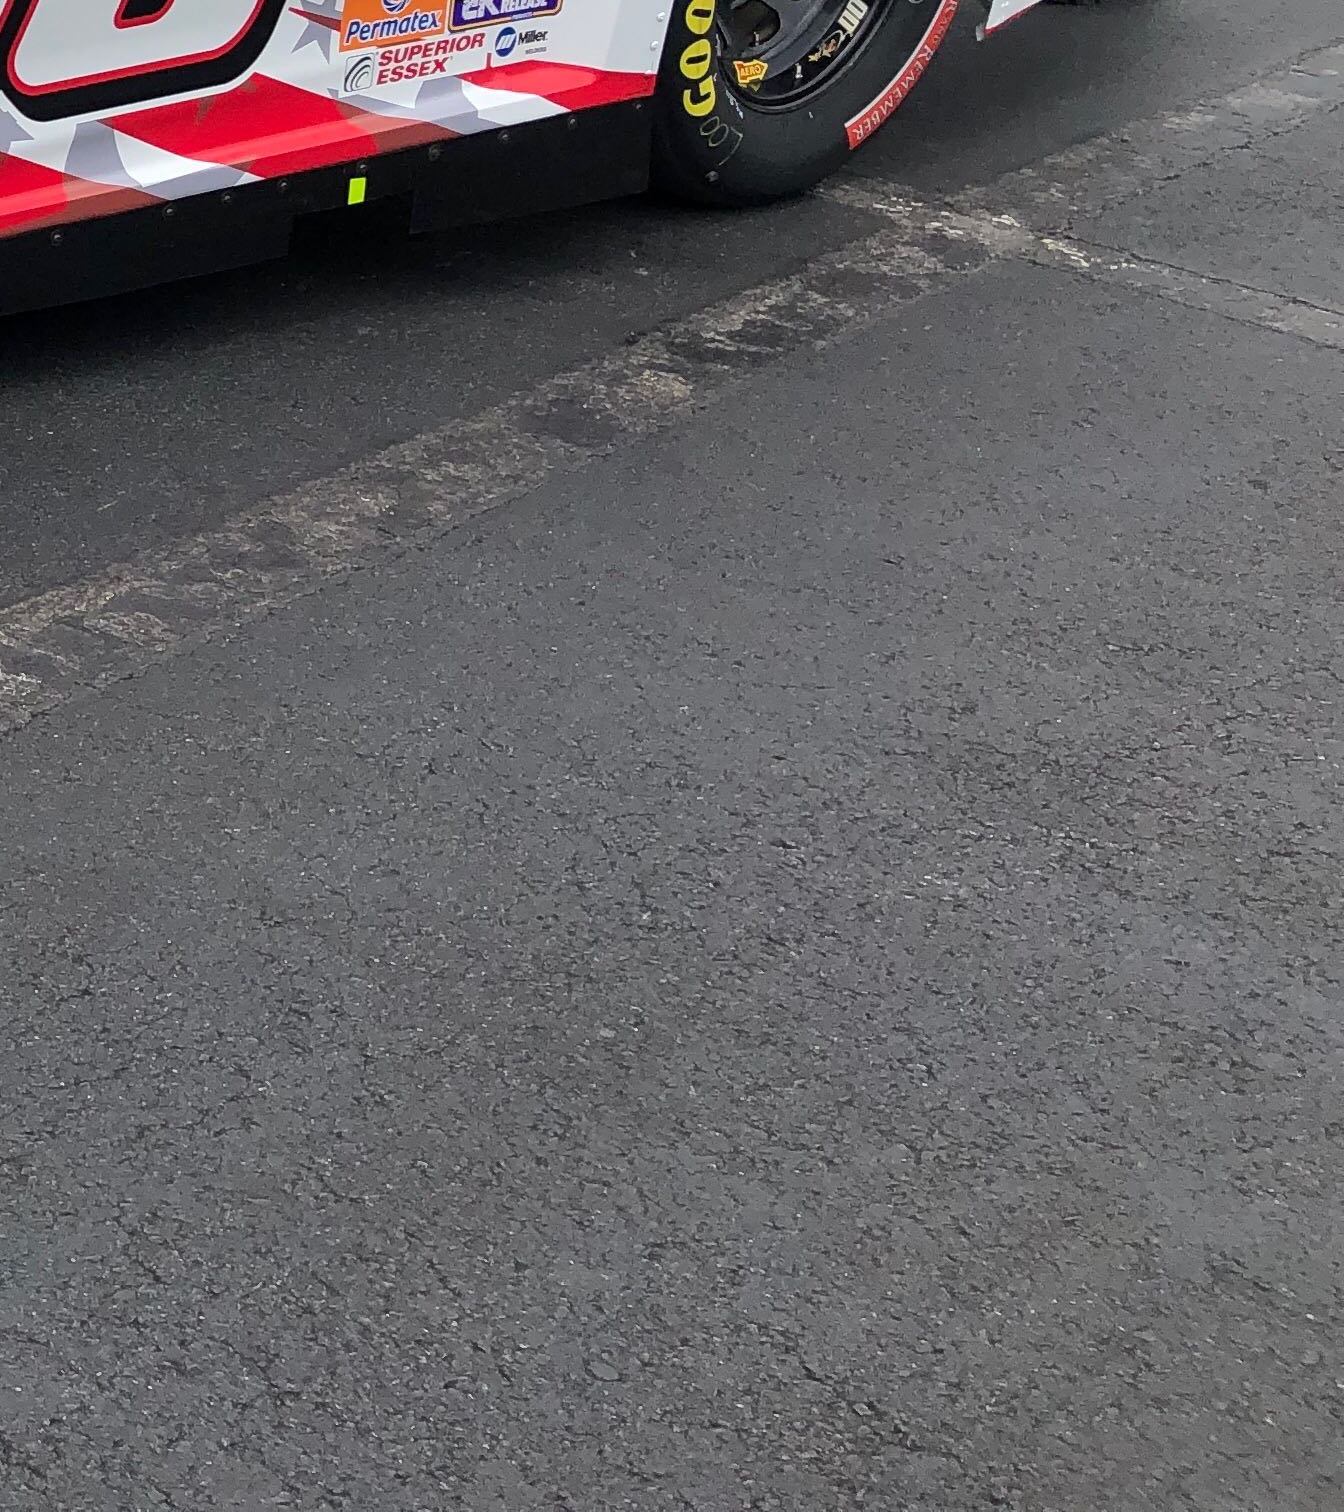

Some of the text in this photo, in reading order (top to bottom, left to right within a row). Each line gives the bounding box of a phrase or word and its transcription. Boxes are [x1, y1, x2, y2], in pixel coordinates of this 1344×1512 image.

[344, 9, 442, 45] Permatex
[518, 29, 549, 46] Miller
[377, 32, 486, 68] SUPERIOR
[376, 56, 450, 86] ESSEX
[739, 62, 762, 79] AERO
[852, 43, 937, 141] REMEMBER
